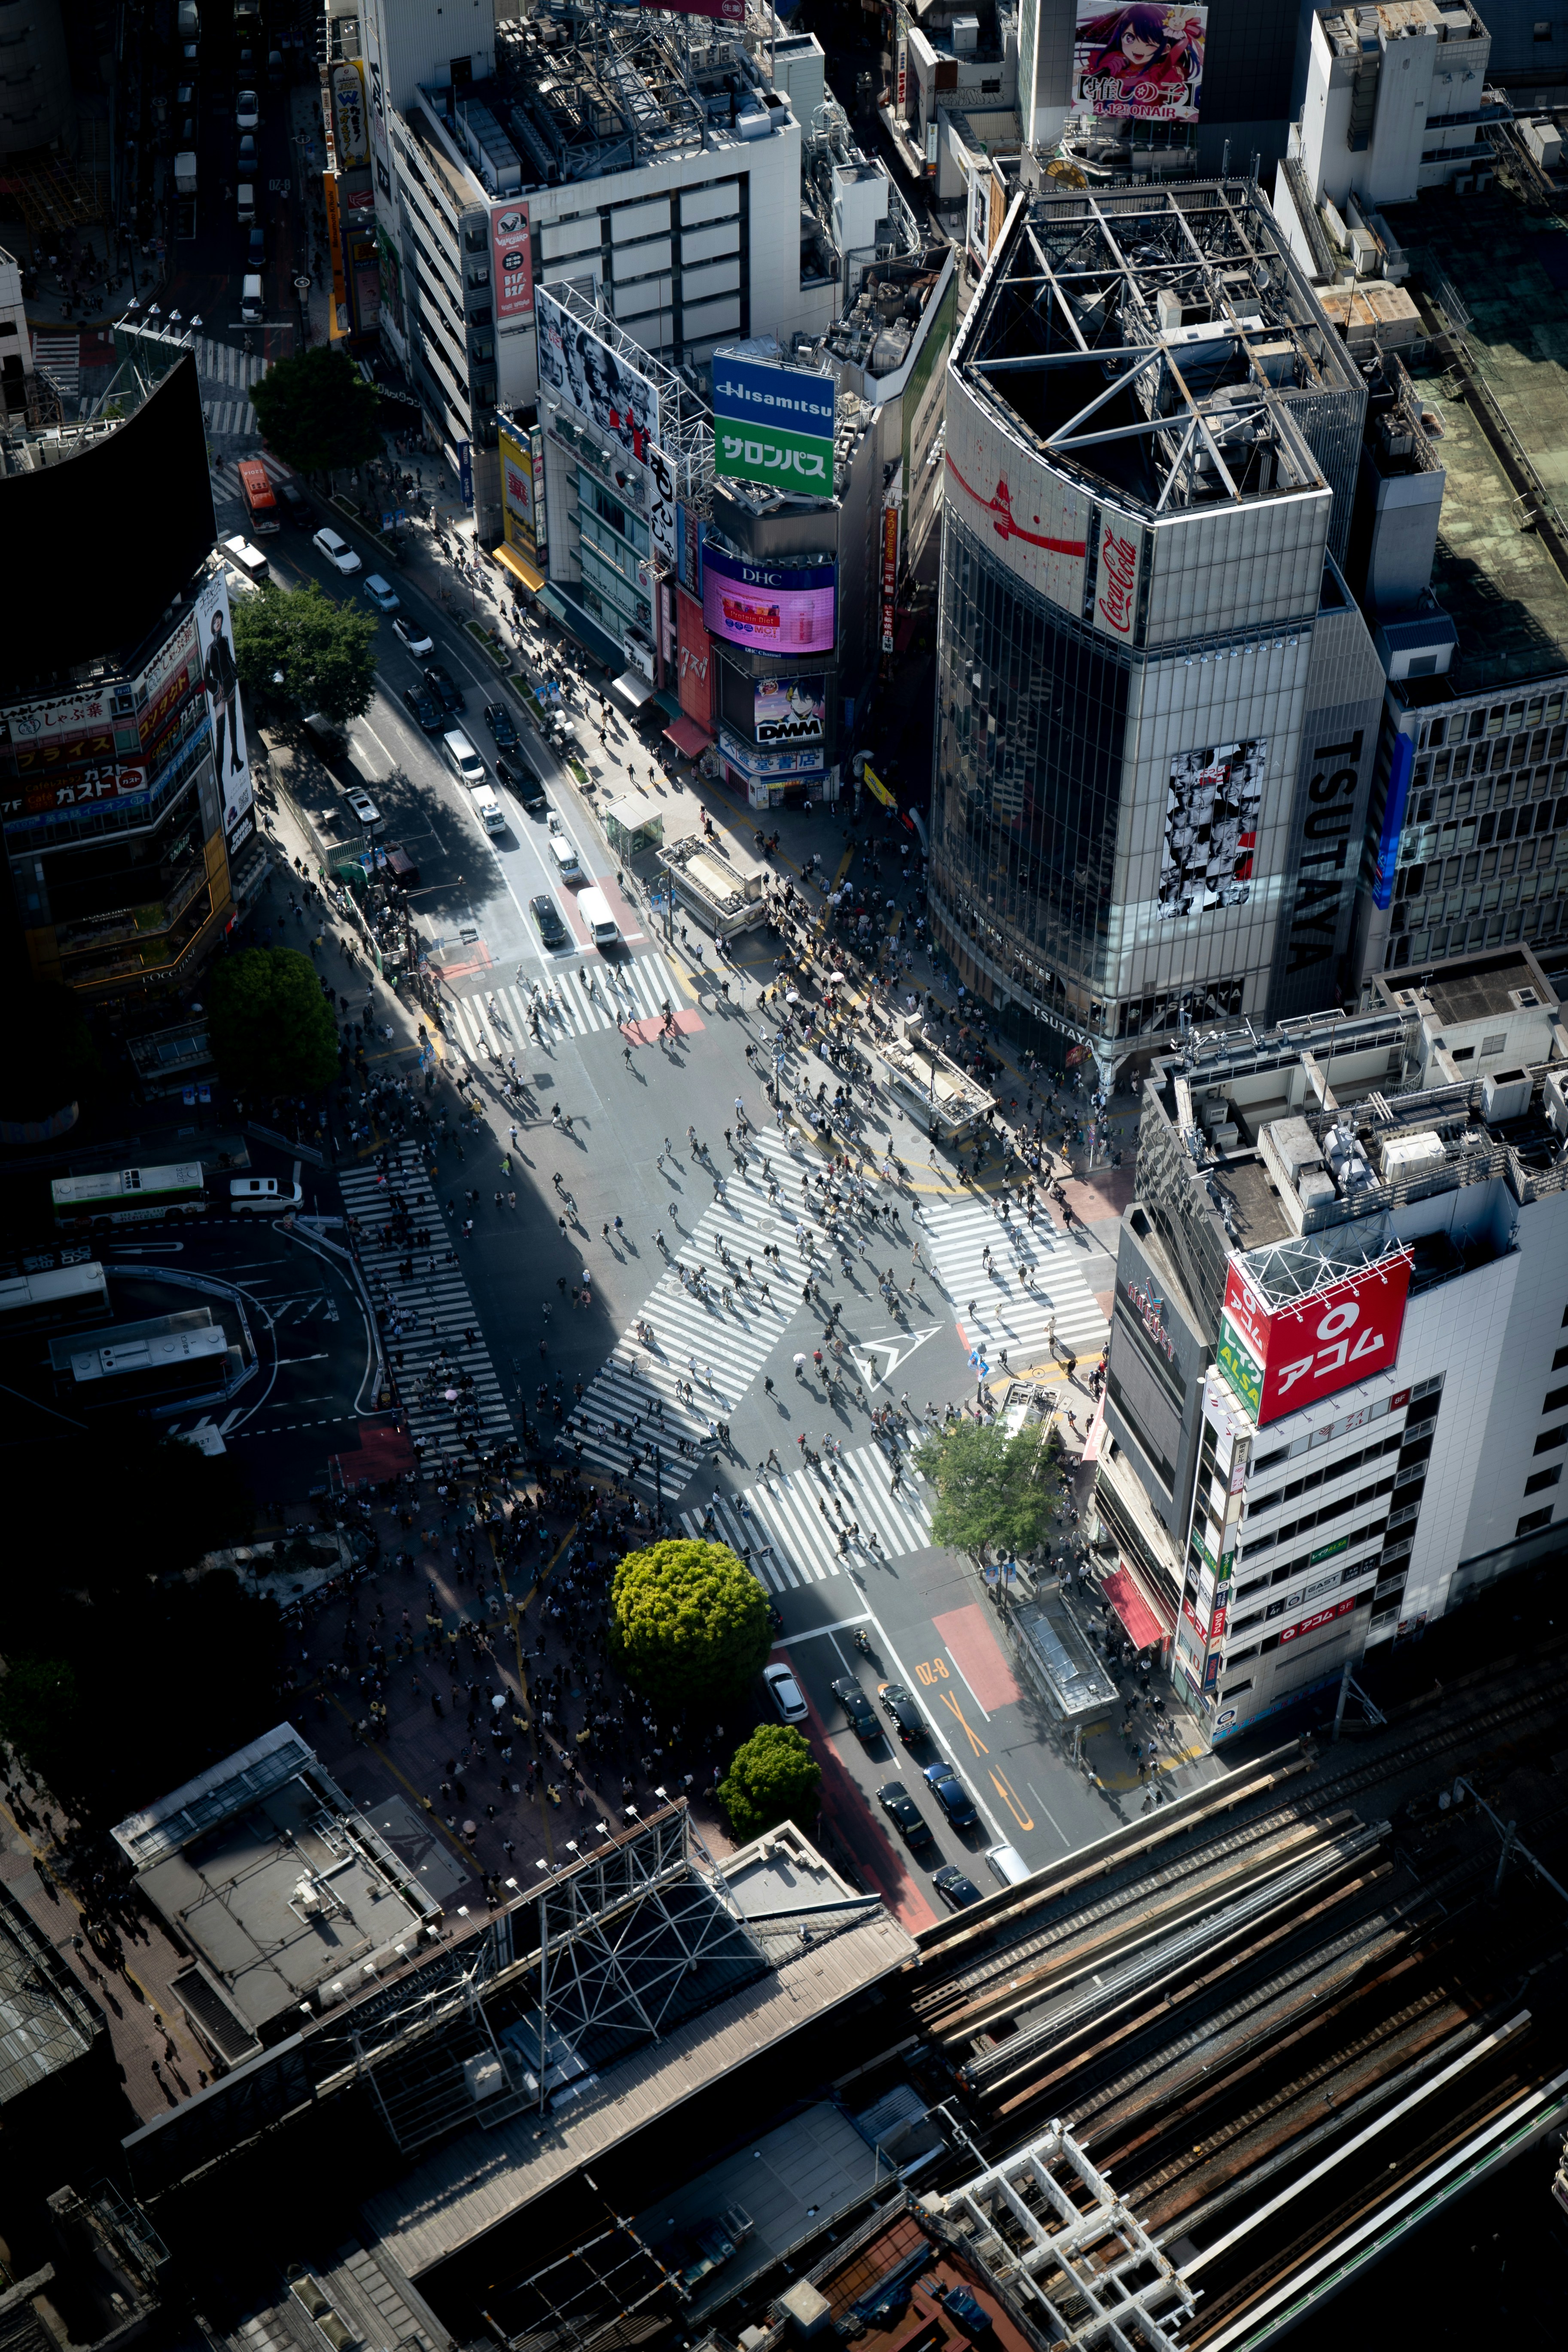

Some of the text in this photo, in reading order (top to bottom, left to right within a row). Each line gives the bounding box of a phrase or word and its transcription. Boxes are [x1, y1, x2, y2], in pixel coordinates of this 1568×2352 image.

[723, 3, 741, 12] 生薬
[330, 214, 338, 248] Matsumoto
[504, 272, 524, 286] B1F
[504, 283, 525, 298] B2F
[716, 381, 832, 417] Hisamitsu
[722, 435, 826, 480] サロンパス
[507, 469, 529, 507] 薬
[650, 452, 674, 557] もんじゃ
[742, 567, 782, 586] DHC
[885, 563, 894, 594] 三千里
[1099, 523, 1137, 633] Coca-Cola
[731, 610, 757, 622] Protein
[754, 626, 777, 634] MCT
[44, 703, 103, 726] しゃぶ葉
[759, 721, 820, 740] DMM
[18, 737, 111, 767] プライス
[85, 763, 128, 783] ガスト
[56, 780, 111, 805] ガスト
[1, 799, 22, 813] 7F
[45, 800, 125, 824] 英会話イーオン
[232, 817, 249, 844] DMM
[1286, 729, 1364, 975] TSUTAYA
[1156, 987, 1242, 1015] TSUTAYA
[1032, 1004, 1095, 1051] TSUTAYA
[176, 1167, 185, 1183] 31217
[22, 1245, 92, 1272] 路線
[1128, 1281, 1175, 1363] MAGNET
[1230, 1289, 1263, 1351] アコム
[1224, 1322, 1262, 1384] レイク
[1278, 1326, 1384, 1395] アコム
[1220, 1346, 1259, 1409] ALSA
[1394, 1394, 1406, 1404] 8F
[1312, 1539, 1347, 1560] レイク ALSA
[1308, 1574, 1339, 1593] EAST
[1270, 1607, 1281, 1616] 4F
[1340, 1600, 1352, 1612] 3F
[1301, 1611, 1333, 1632] アコム
[915, 1657, 950, 1686] 8-20
[1215, 1720, 1233, 1731] EAST
